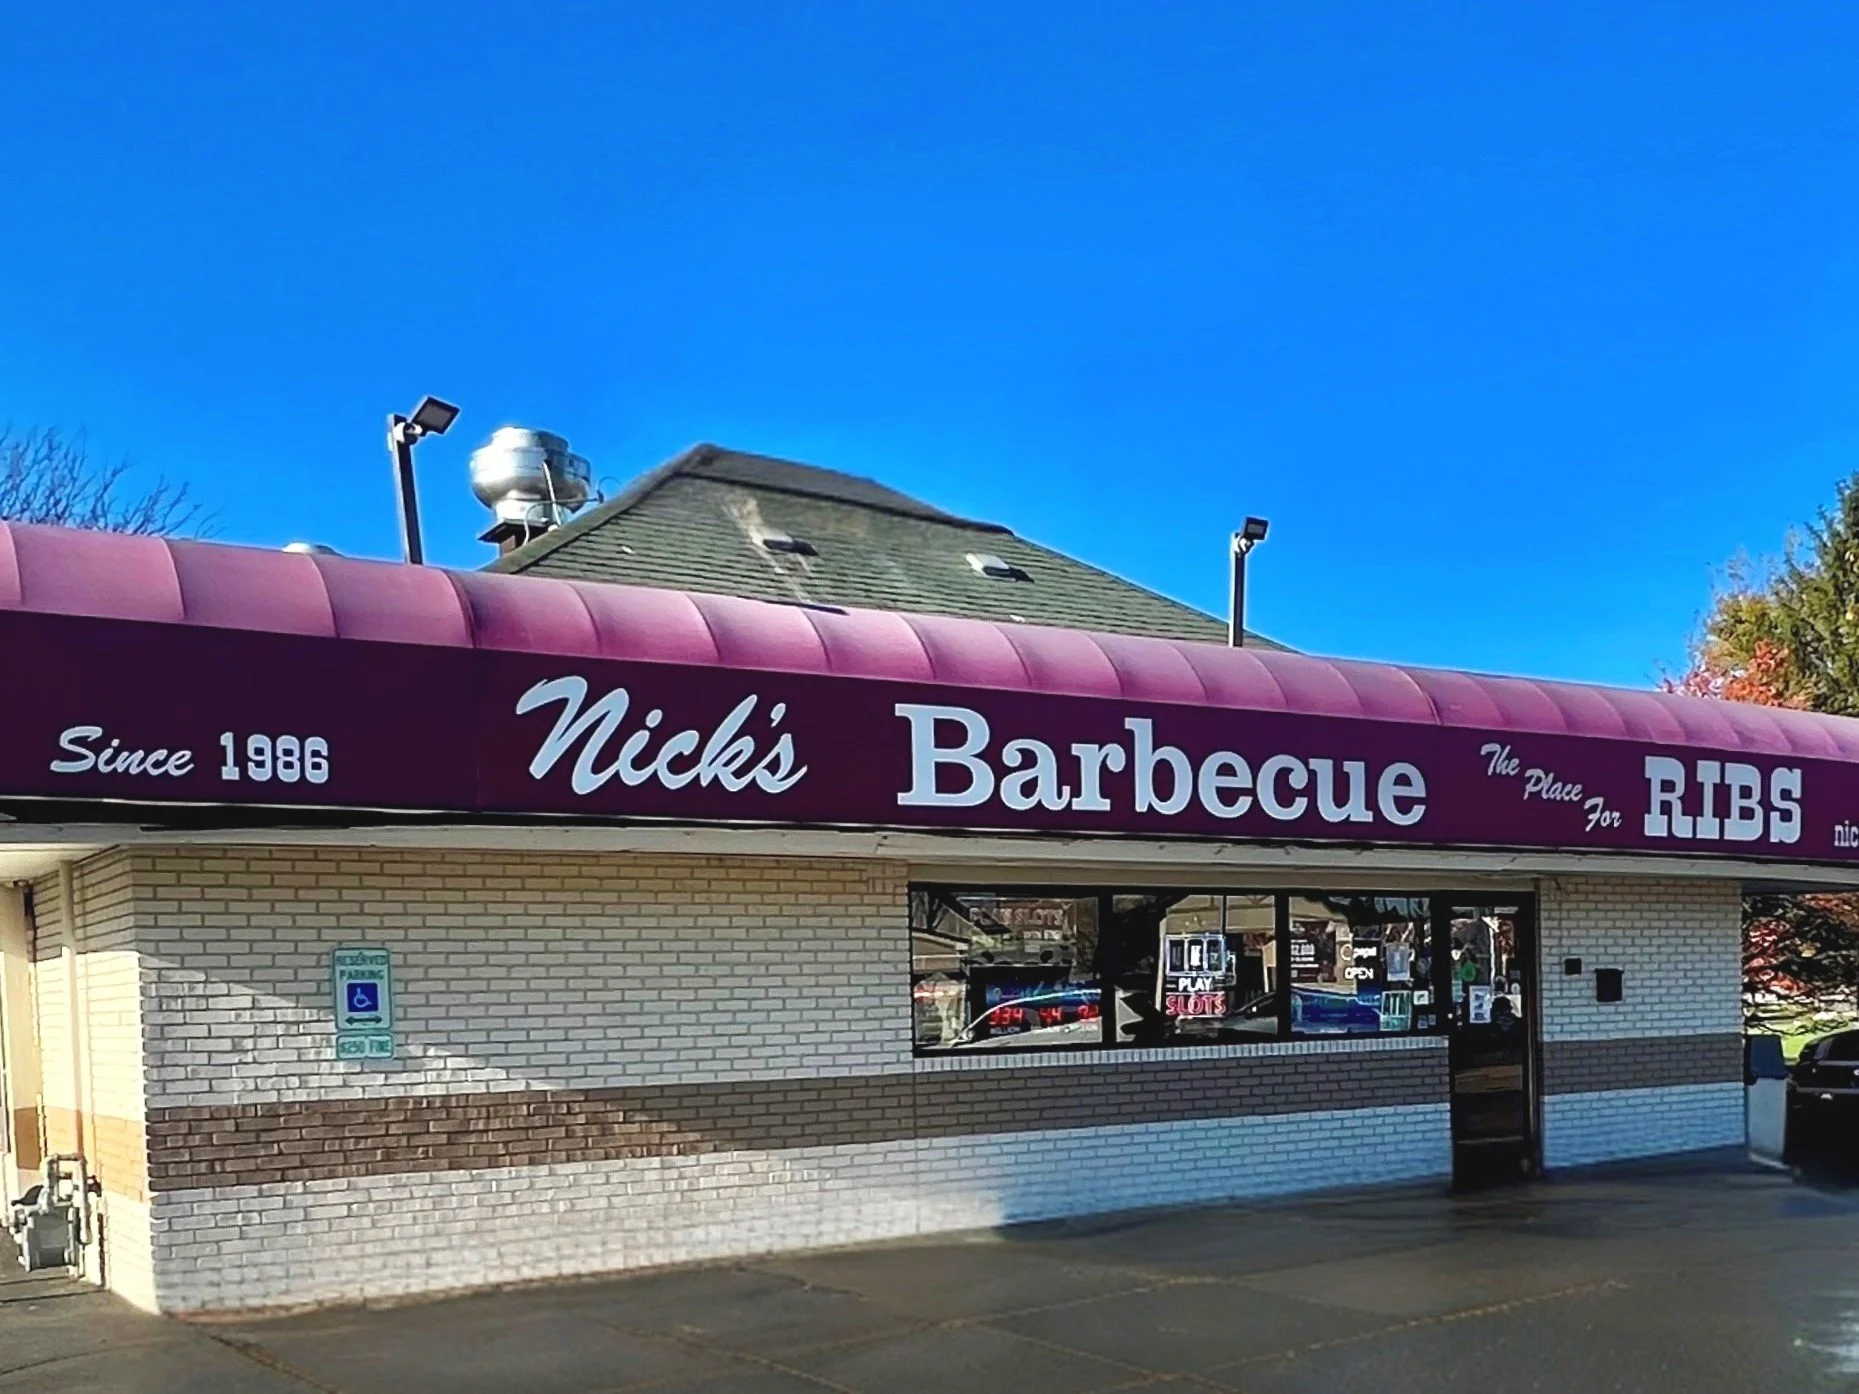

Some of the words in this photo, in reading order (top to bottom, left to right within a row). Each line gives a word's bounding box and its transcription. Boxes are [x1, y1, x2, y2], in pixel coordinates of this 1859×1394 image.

[50, 726, 194, 777] Since
[221, 732, 329, 784] 1986
[516, 676, 808, 795] Nick's
[895, 703, 1426, 826] Barbecue
[1480, 743, 1520, 776] The
[1524, 769, 1583, 801] Place
[1583, 797, 1622, 832] For
[1644, 756, 1802, 844] RIBS
[336, 955, 387, 965] RESERVED
[340, 969, 384, 980] PARKING
[1344, 967, 1374, 979] OPEN
[1179, 977, 1212, 992] PLAY
[1165, 994, 1226, 1015] SLOTS
